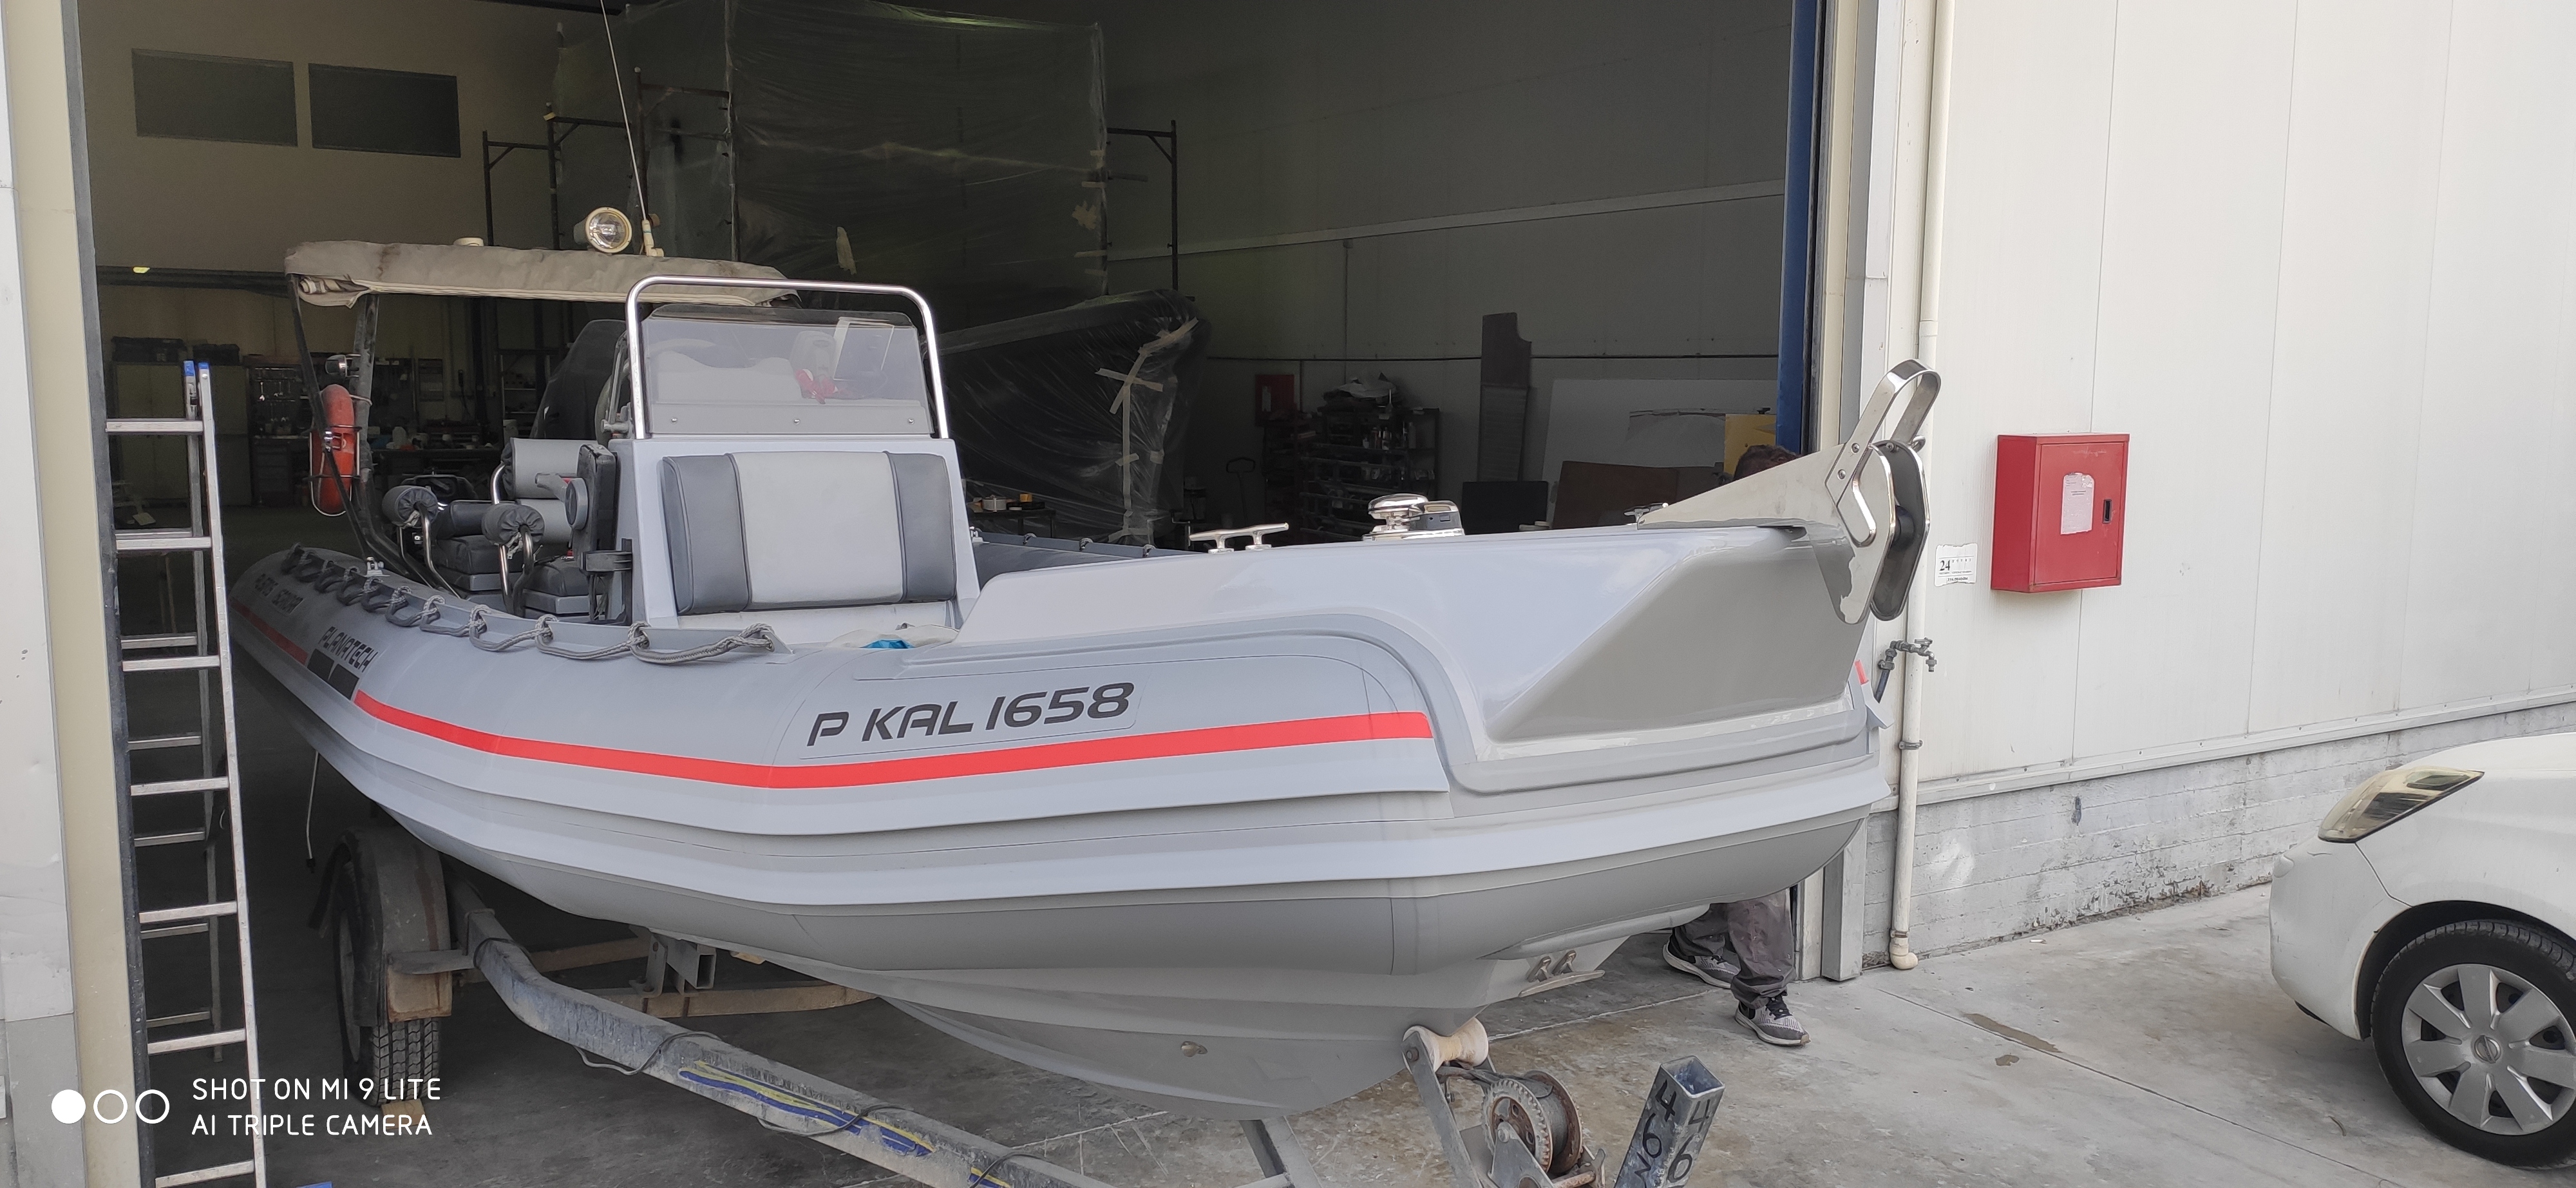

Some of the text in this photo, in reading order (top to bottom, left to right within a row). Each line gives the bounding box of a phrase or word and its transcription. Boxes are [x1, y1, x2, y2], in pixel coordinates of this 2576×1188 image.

[1939, 559, 1951, 571] 24
[317, 626, 379, 673] PLANATECH
[807, 682, 1135, 747] P KAL 1658
